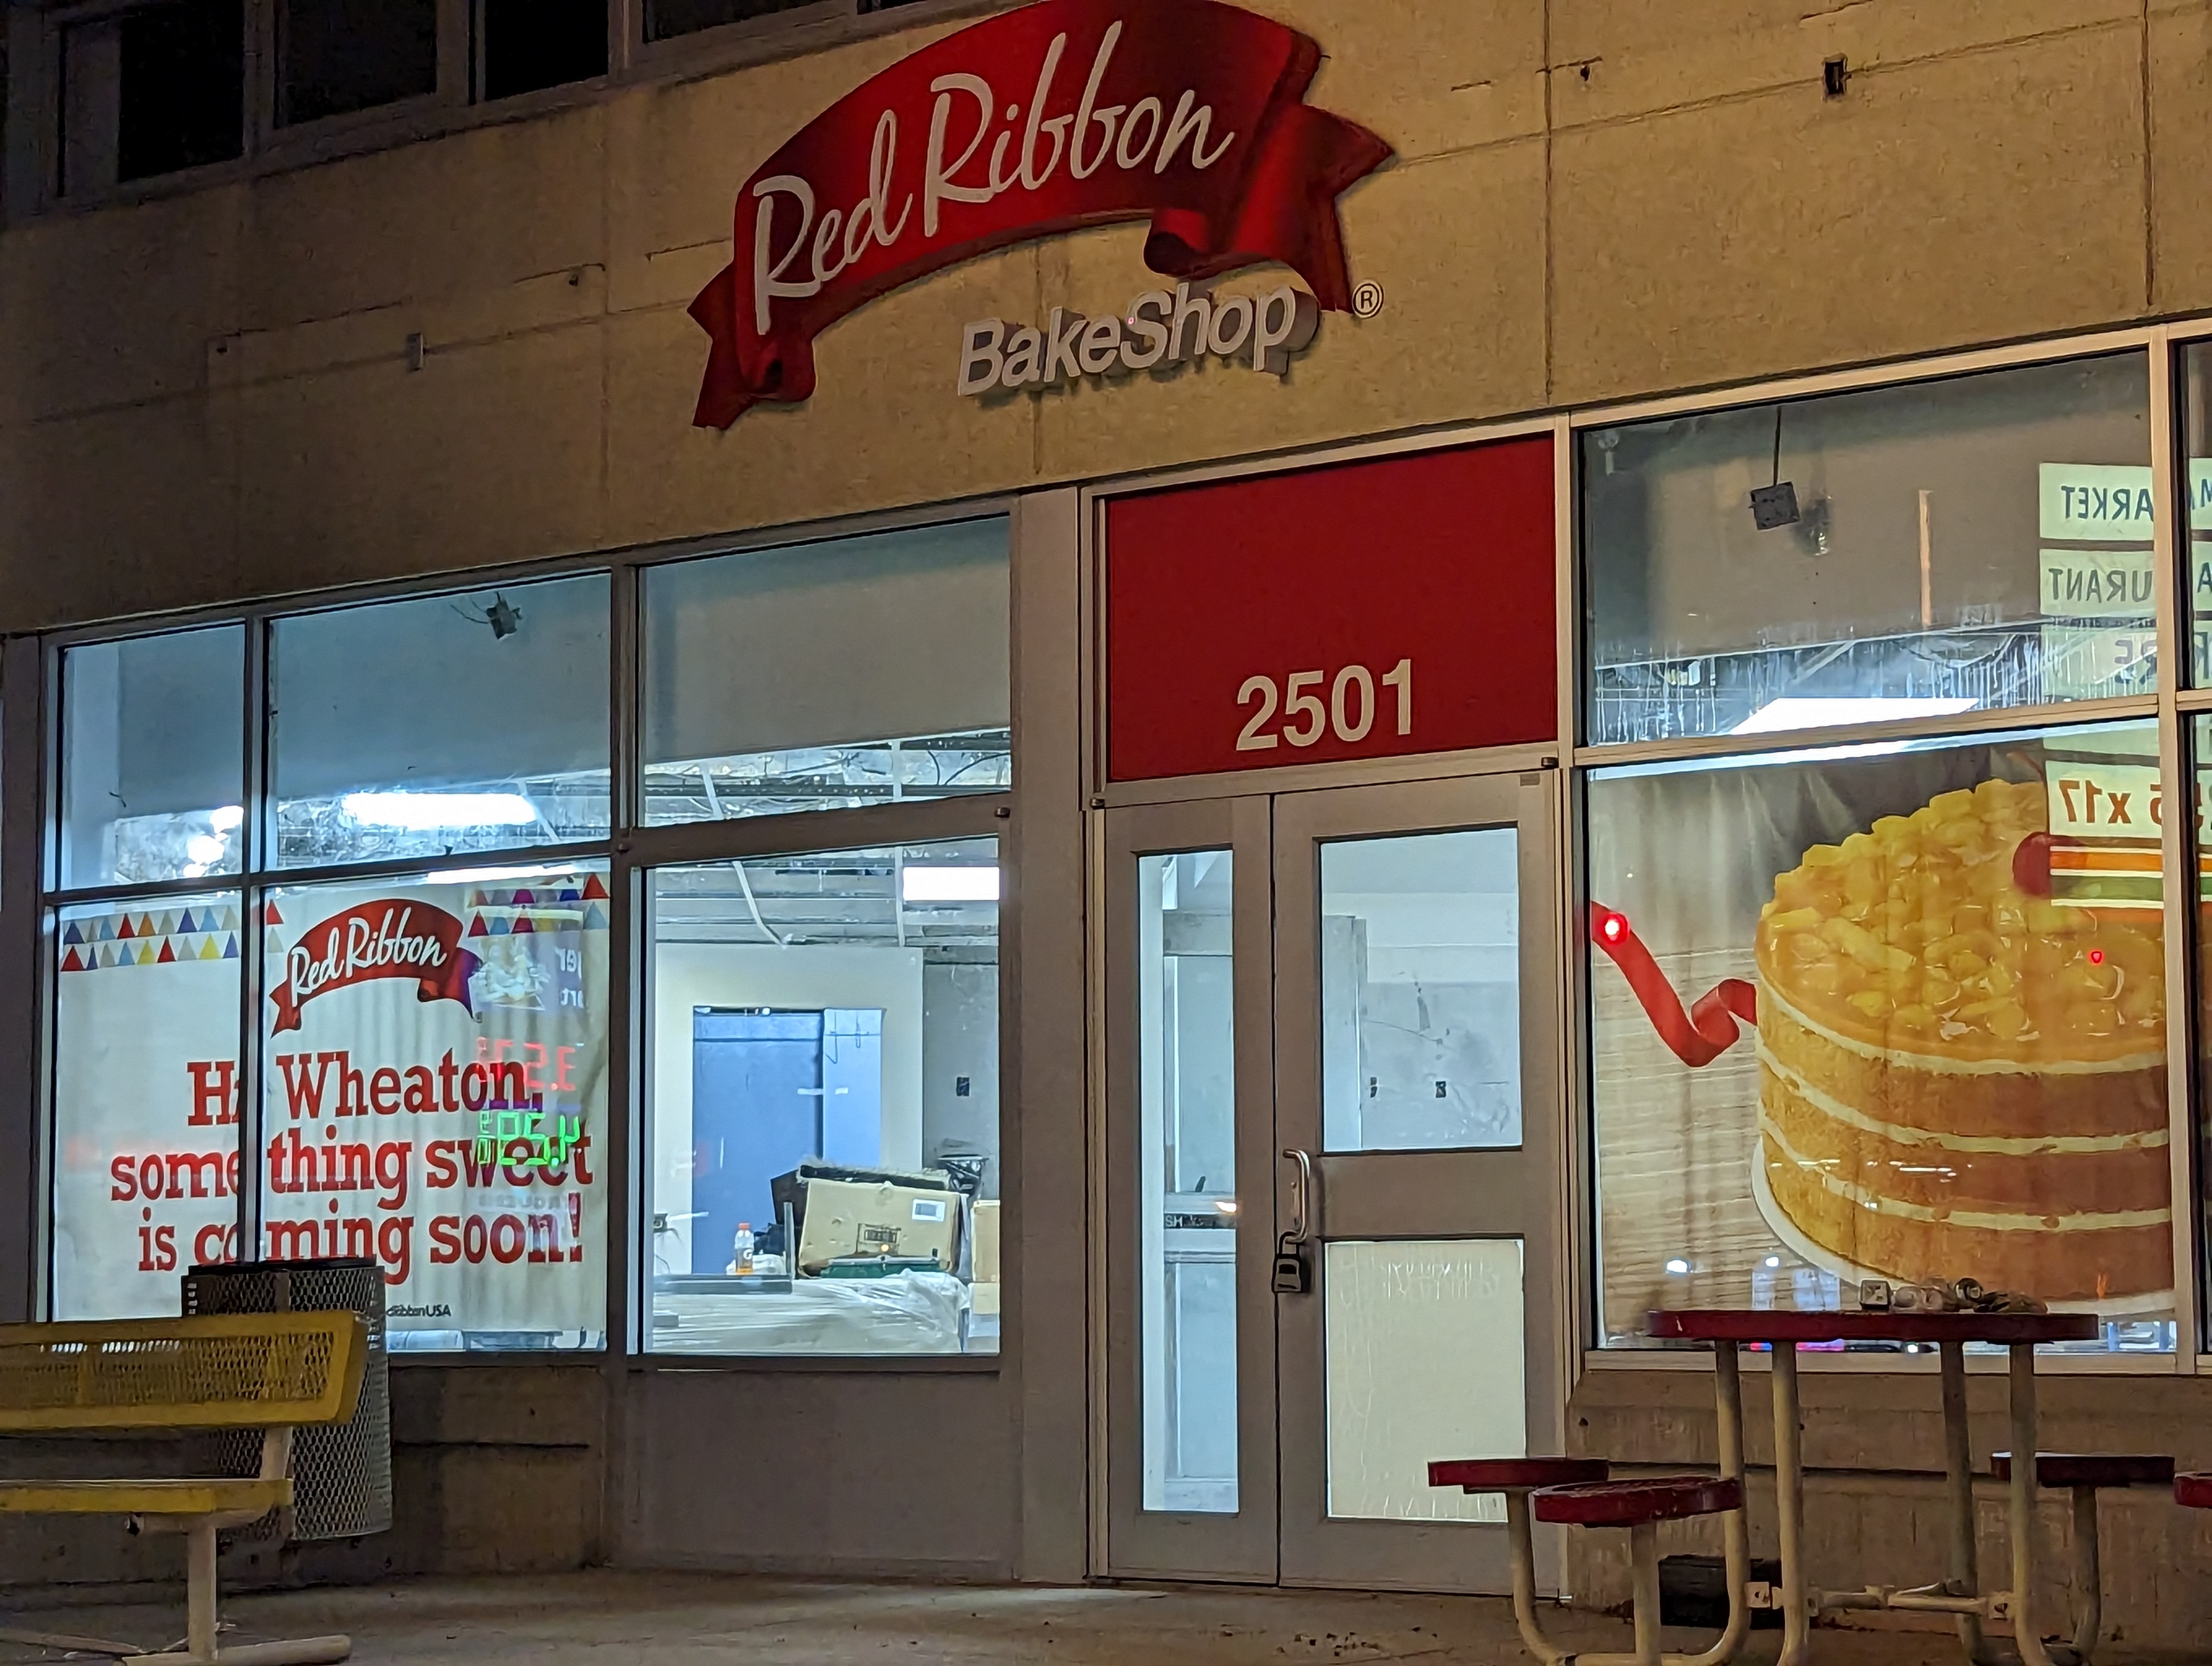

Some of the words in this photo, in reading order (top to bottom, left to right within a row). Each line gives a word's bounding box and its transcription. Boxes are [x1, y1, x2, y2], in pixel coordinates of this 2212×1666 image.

[752, 108, 914, 335] Red
[923, 20, 1235, 237] Ribbon
[957, 281, 1298, 398] BakeShop
[1236, 658, 1412, 751] 2501
[291, 926, 344, 1008] Red
[345, 907, 447, 977] Ribbon
[275, 1048, 543, 1120] Wheaton,
[424, 1120, 594, 1189] sweet
[138, 1207, 177, 1271] is
[428, 1192, 583, 1265] soon!
